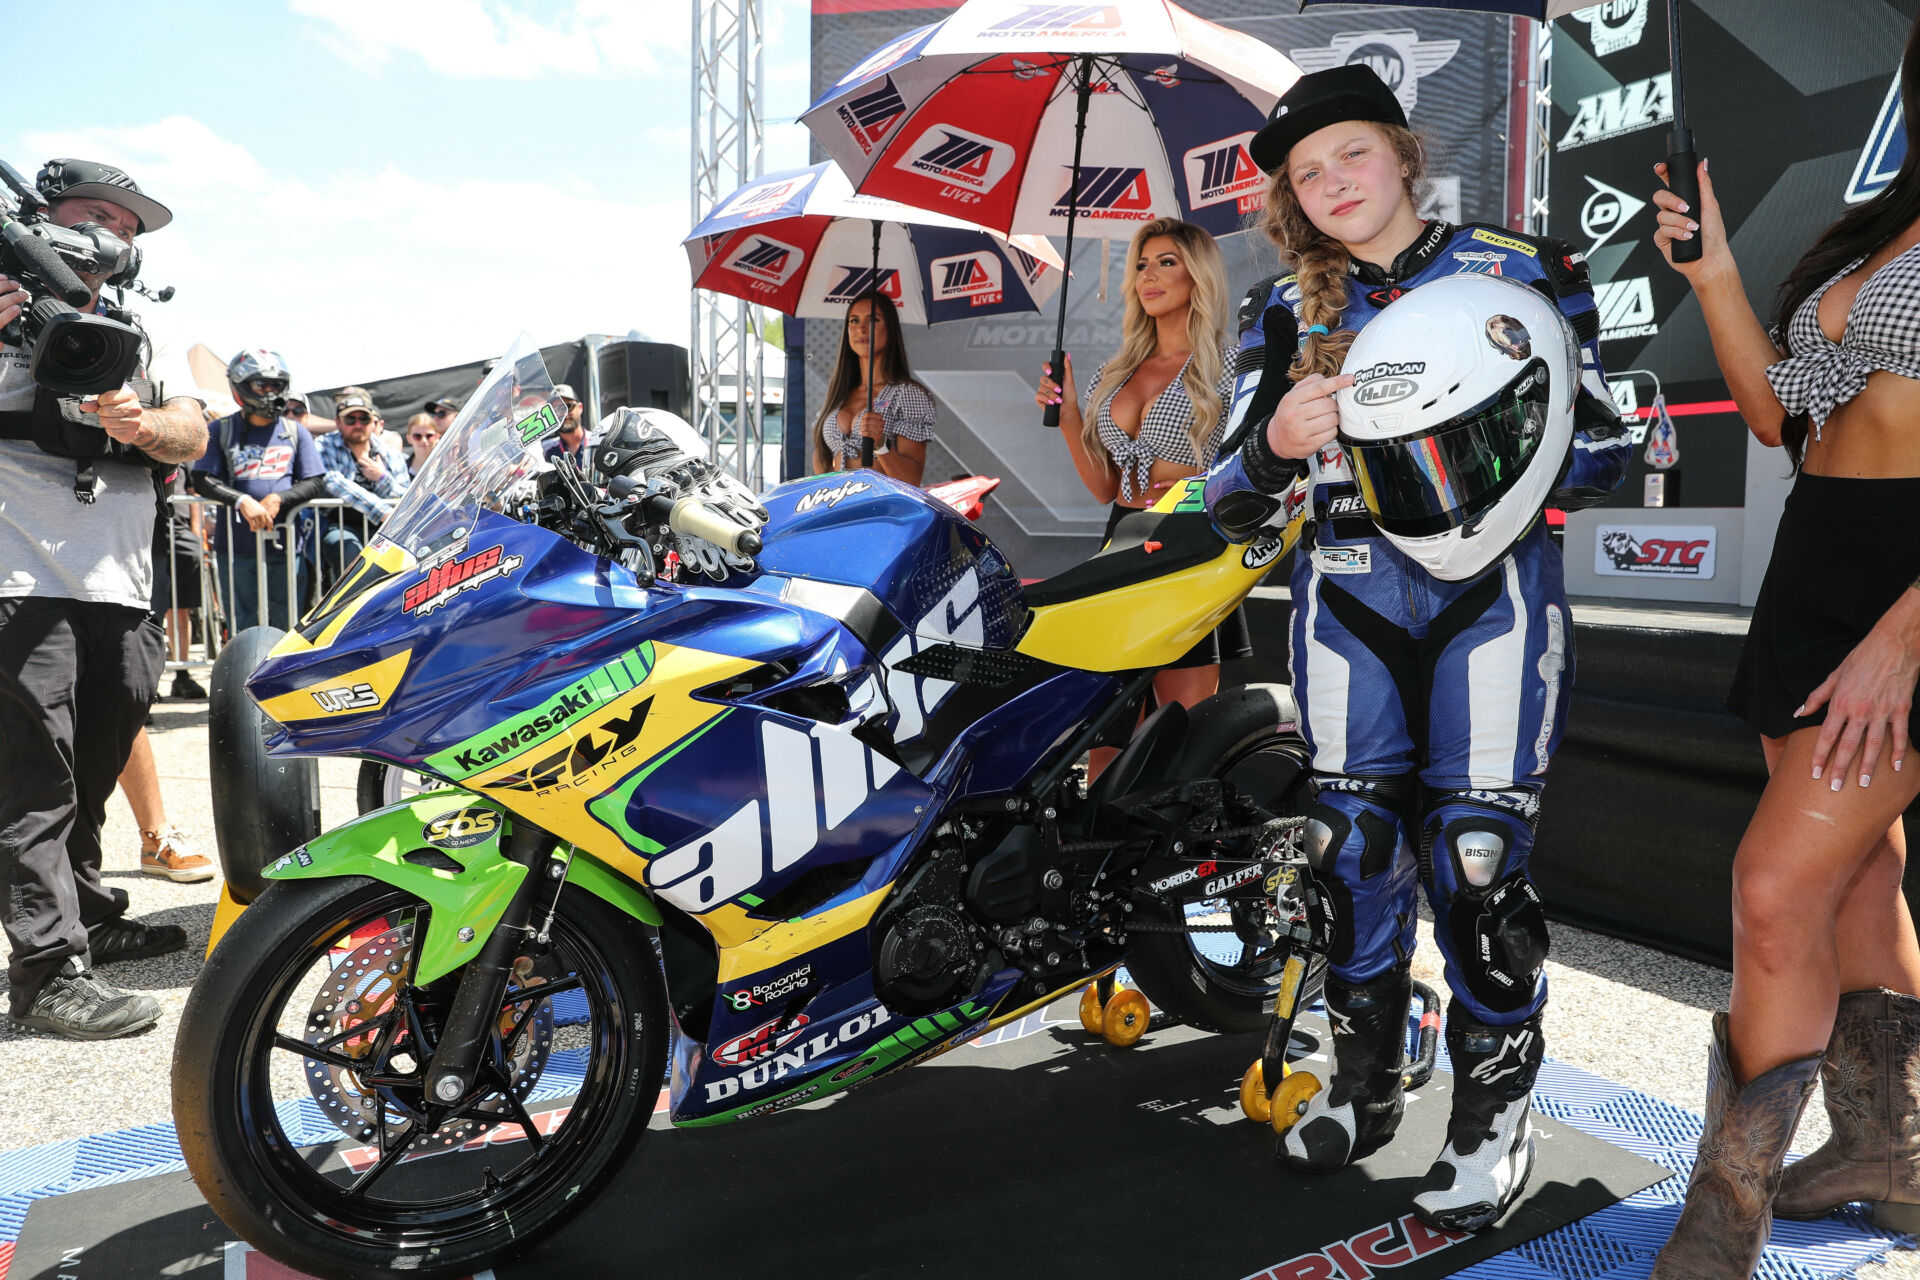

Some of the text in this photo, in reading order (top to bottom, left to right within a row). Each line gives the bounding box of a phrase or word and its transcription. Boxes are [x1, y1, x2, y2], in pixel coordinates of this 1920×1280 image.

[911, 160, 984, 188] MOTOAMERICA
[1485, 234, 1537, 254] DUNLOP
[941, 281, 995, 295] MOTOAMERICA
[1374, 362, 1425, 379] DYLAN
[1361, 380, 1408, 404] HJC
[1517, 376, 1534, 395] HJC
[516, 403, 558, 444] 31
[795, 480, 873, 512] Ninja
[1323, 551, 1368, 565] HELITE
[1635, 538, 1711, 565] STG
[404, 545, 502, 612] altus
[310, 682, 381, 712] WPS
[453, 683, 595, 773] Kawasaki
[481, 693, 656, 793] FLY
[535, 744, 638, 798] RACING
[427, 808, 497, 842] sbs
[1464, 847, 1500, 859] BISON
[1150, 865, 1199, 893] VORTEX
[1205, 863, 1263, 896] GALFER
[1320, 896, 1335, 922] STREET
[752, 963, 812, 997] Bonamici
[764, 976, 809, 1003] Racing
[1489, 968, 1514, 987] STREET
